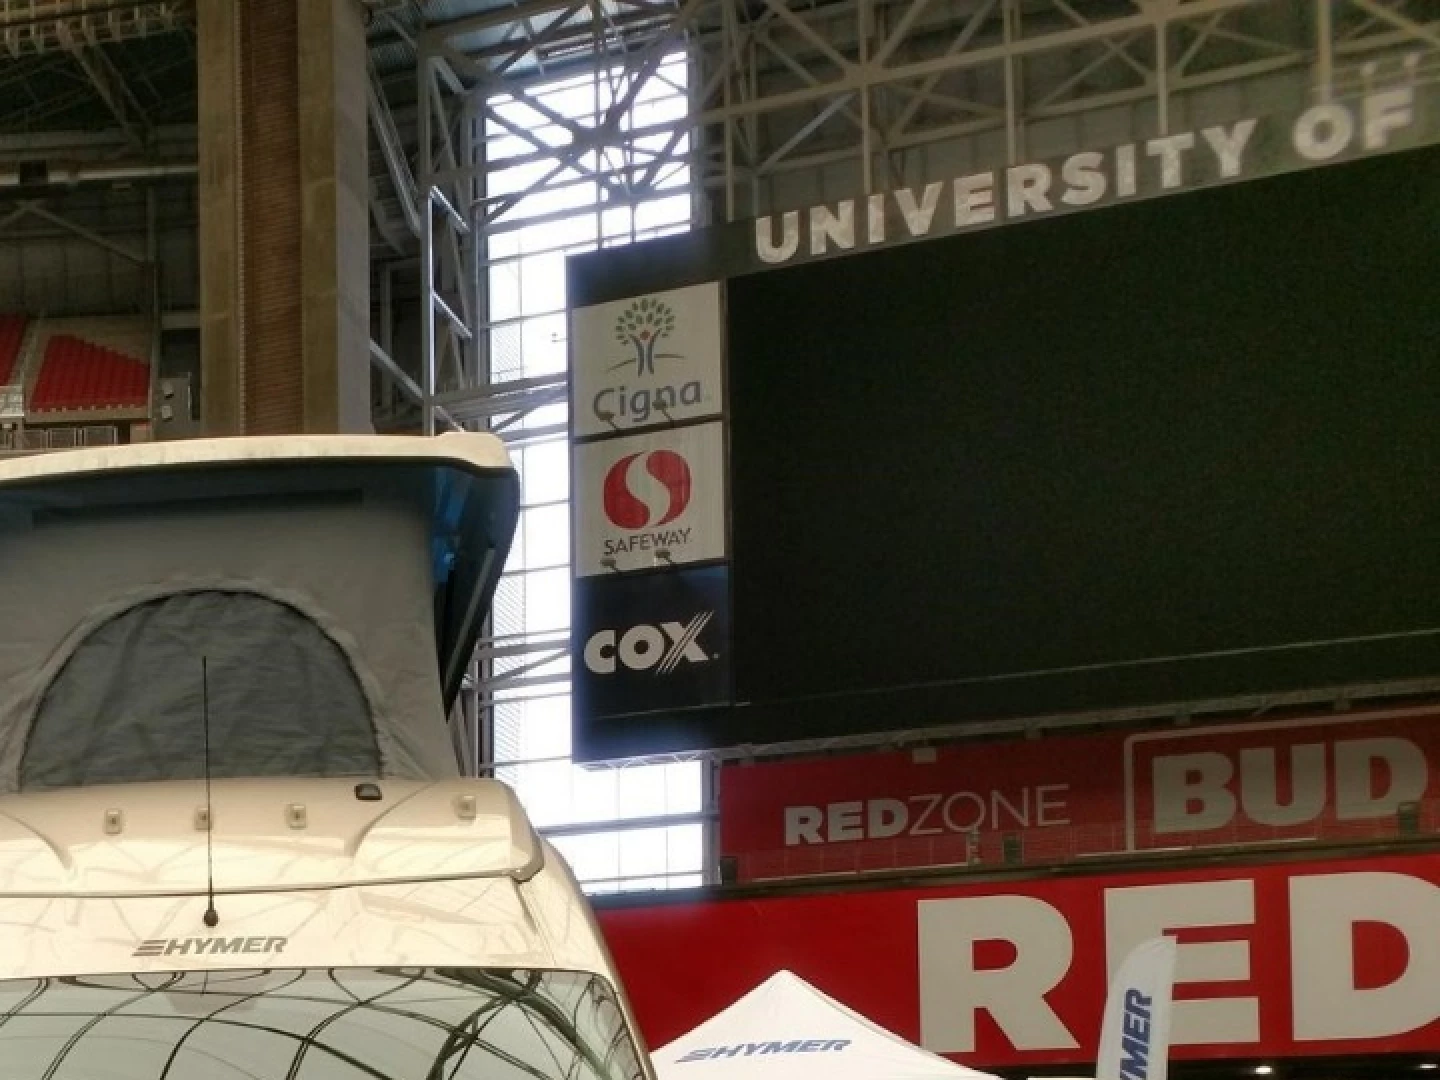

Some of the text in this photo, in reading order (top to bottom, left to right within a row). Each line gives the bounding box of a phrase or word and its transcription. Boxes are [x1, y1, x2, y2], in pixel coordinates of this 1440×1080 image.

[754, 89, 1414, 264] UNIVERSITY OF
[593, 380, 702, 423] Cigna
[603, 527, 692, 556] SAFEWAY
[583, 611, 714, 675] COX
[1151, 736, 1429, 835] BUD
[163, 936, 289, 955] HYMER
[917, 871, 1440, 1054] RED
[710, 1039, 853, 1060] HYMER
